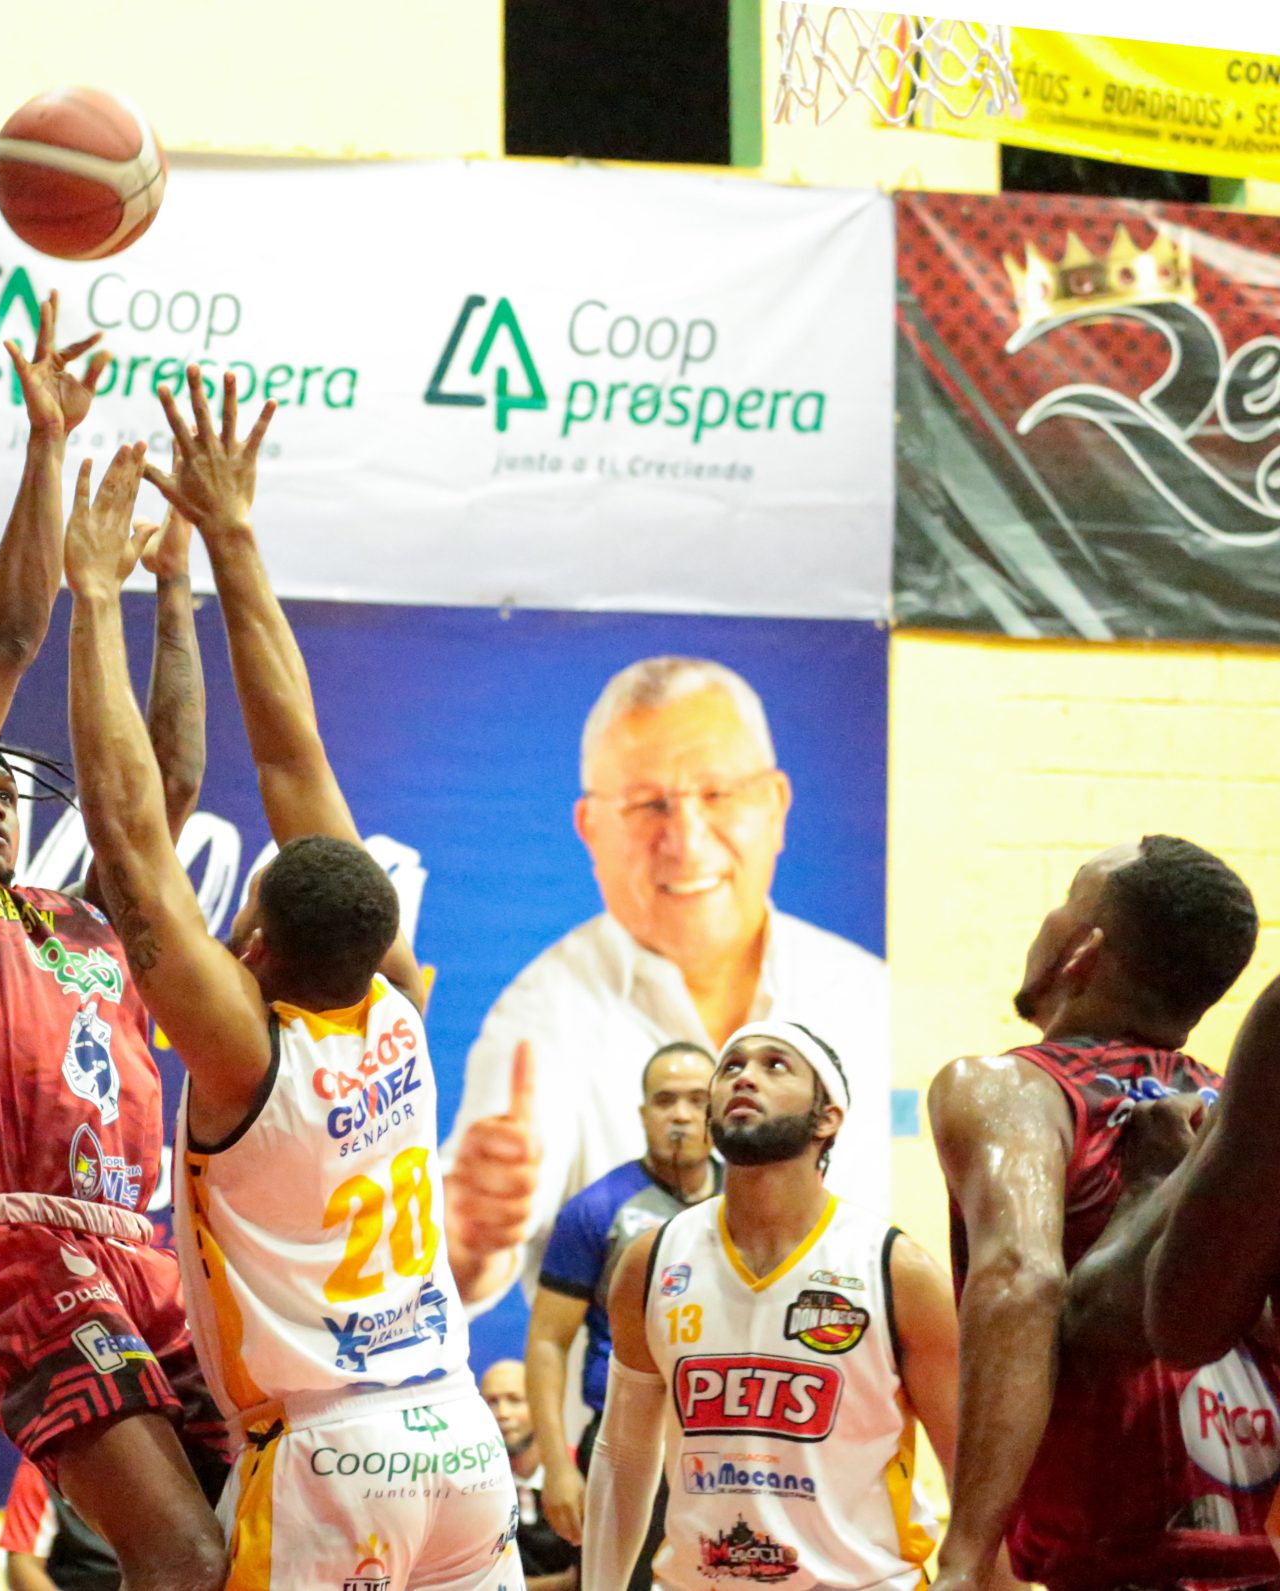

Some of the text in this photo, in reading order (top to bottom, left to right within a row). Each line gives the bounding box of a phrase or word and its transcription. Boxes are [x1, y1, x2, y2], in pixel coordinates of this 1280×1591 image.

[87, 272, 242, 350] Coop
[568, 299, 718, 377] Coop
[665, 1304, 704, 1345] 13
[685, 1367, 824, 1424] PETS
[1198, 1387, 1276, 1448] Rica
[719, 1463, 816, 1493] Mocana
